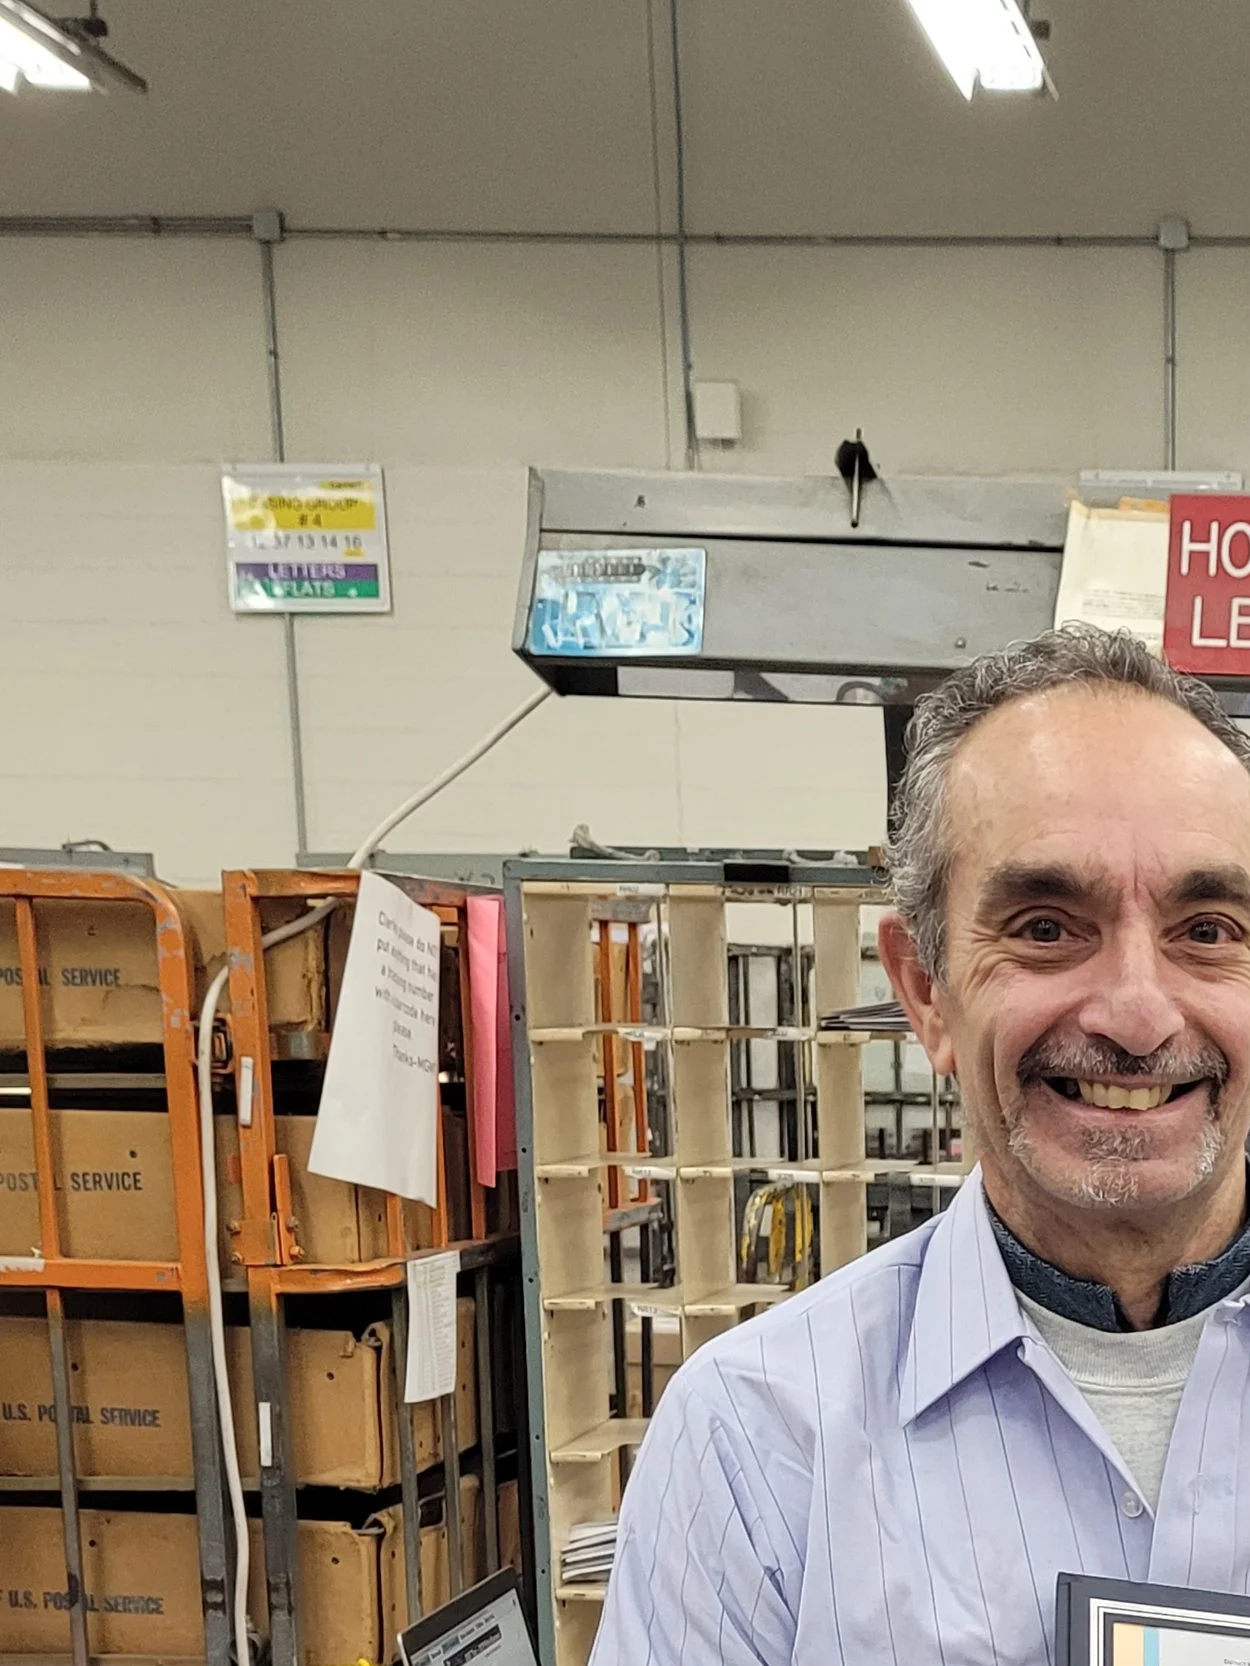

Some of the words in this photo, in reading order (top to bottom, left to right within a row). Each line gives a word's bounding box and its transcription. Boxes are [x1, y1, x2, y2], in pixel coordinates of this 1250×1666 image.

[268, 562, 346, 579] LETTERS
[283, 581, 336, 597] FLATS
[62, 968, 121, 987] SERVICE
[0, 1172, 63, 1192] POSTL
[71, 1172, 143, 1192] SERVICE
[3, 1404, 31, 1422] U.S.
[38, 1406, 94, 1424] POTAL
[101, 1407, 161, 1428] SERVICE
[9, 1590, 37, 1609] U.S.
[103, 1597, 164, 1616] SERVICE
